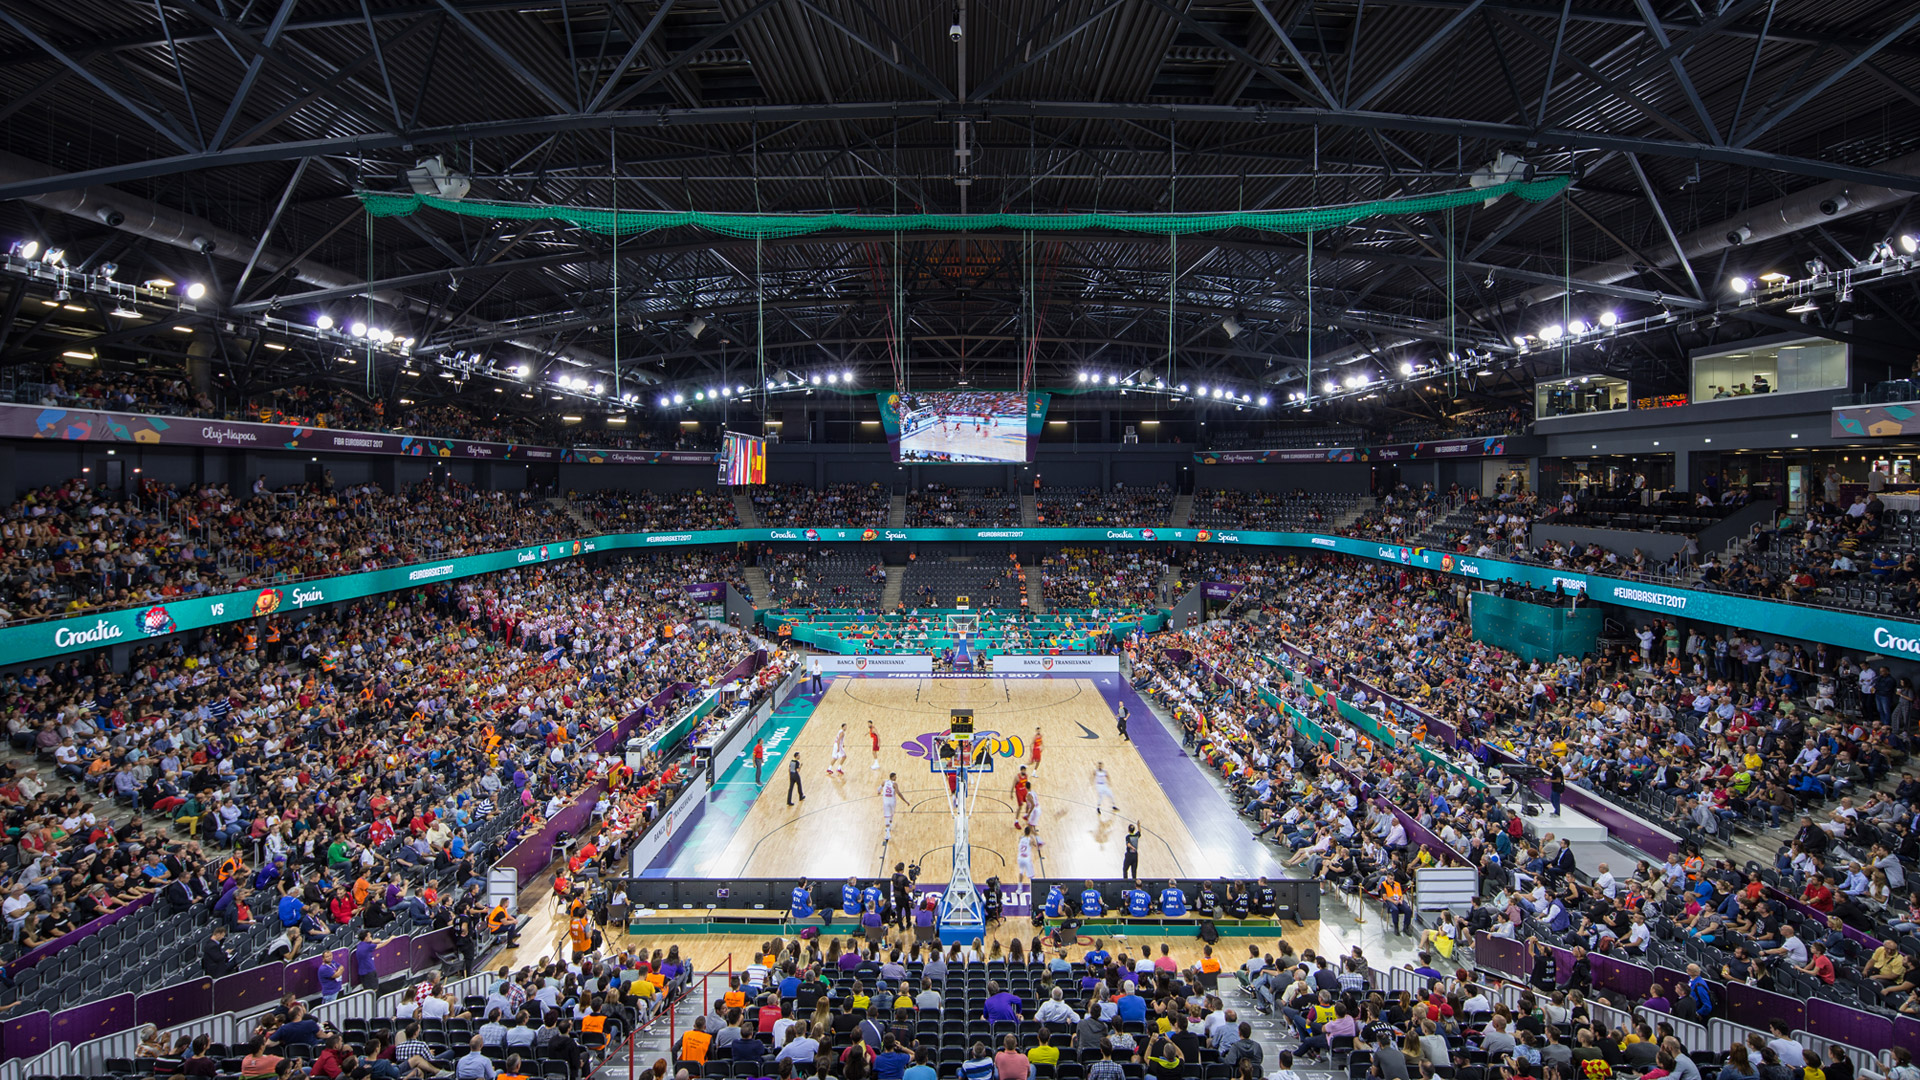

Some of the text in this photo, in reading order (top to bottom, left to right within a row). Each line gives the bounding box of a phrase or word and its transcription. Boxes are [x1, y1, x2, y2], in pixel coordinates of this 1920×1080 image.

[202, 426, 257, 444] Cluj-Napoca
[334, 437, 384, 448] FIBA EUROBASKET 2017
[646, 534, 692, 543] #EUROBASKET2017
[771, 530, 797, 539] Croatia
[885, 531, 907, 541] Spain
[1107, 530, 1133, 539] Croatia
[1218, 532, 1239, 543] Spain
[584, 541, 595, 553] Spain
[1379, 547, 1396, 559] Croatia
[518, 552, 536, 563] Croatia
[1423, 555, 1429, 564] VS
[409, 564, 454, 581] #EUROBASKET2017
[1460, 559, 1479, 576] Spain
[292, 586, 325, 609] Spain
[1613, 587, 1687, 609] #EUROBASKET2017
[211, 602, 224, 616] VS
[55, 619, 123, 648] Croatia
[653, 824, 666, 843] BANCA
